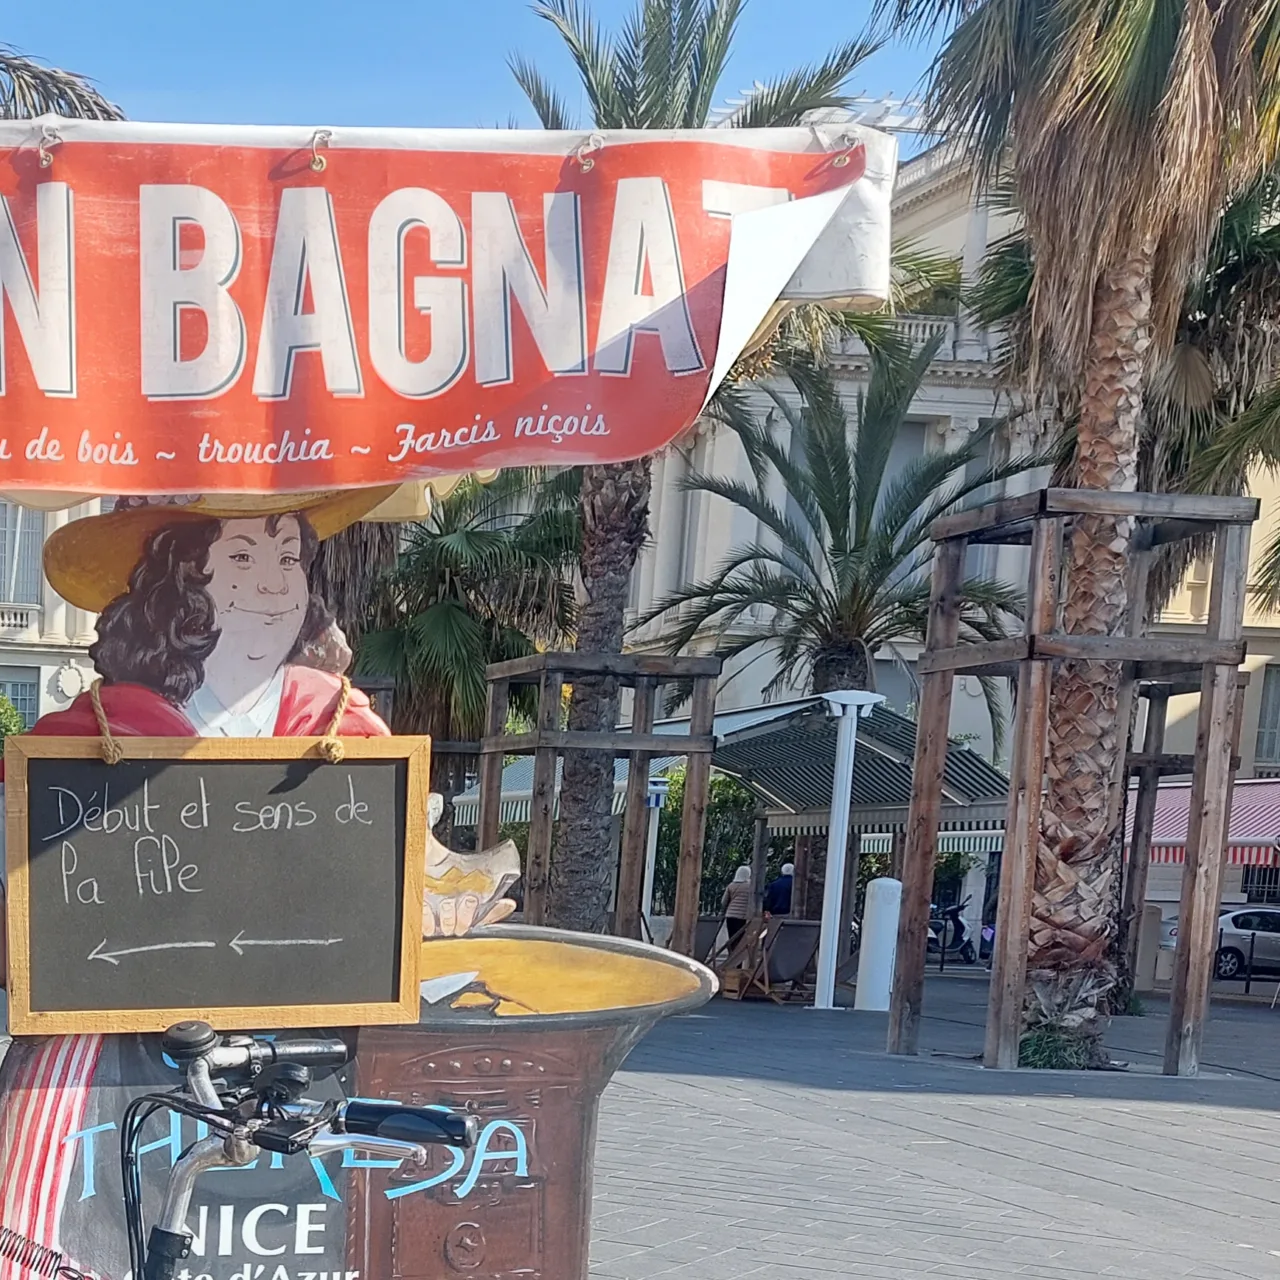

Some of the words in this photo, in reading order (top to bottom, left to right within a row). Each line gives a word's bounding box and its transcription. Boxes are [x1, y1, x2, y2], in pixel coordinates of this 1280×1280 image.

[25, 426, 65, 462] de
[77, 430, 139, 466] bois
[198, 429, 335, 464] trouchia
[388, 413, 501, 463] Farcis
[514, 404, 611, 444] niçois
[42, 777, 160, 841] Début
[180, 776, 209, 829] et
[233, 800, 317, 832] sens
[335, 774, 372, 825] de
